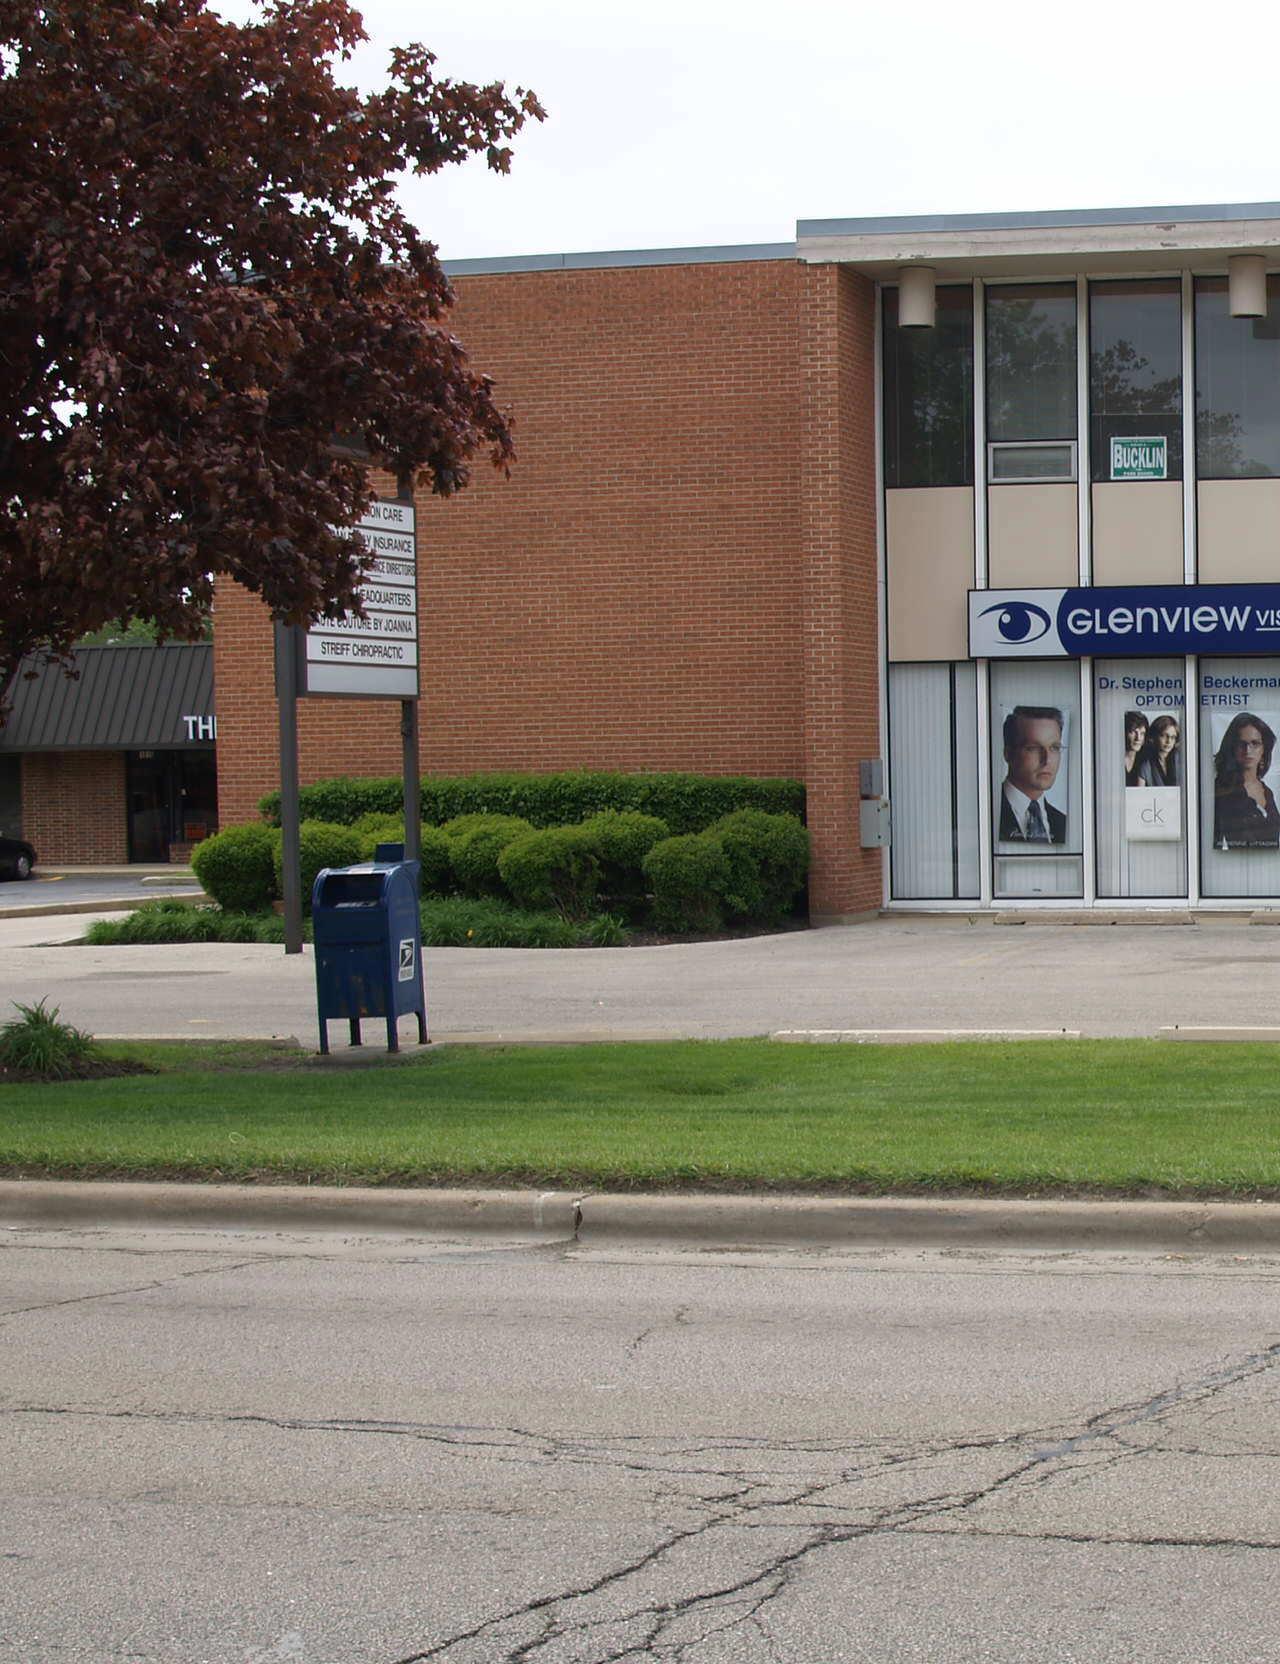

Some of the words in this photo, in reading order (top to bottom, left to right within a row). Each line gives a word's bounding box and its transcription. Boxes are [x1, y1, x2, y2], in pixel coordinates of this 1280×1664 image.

[1114, 444, 1164, 468] BUCKLIN
[382, 507, 403, 522] CARE
[373, 536, 413, 553] INSURANCE
[386, 561, 416, 577] DIRECTORS
[373, 618, 383, 631] BY
[384, 619, 413, 633] JOANNA
[321, 641, 351, 656] STREIFF
[352, 643, 404, 660] CHIROPRACTIC
[1099, 677, 1119, 690] Dr.
[1122, 676, 1183, 694] Stephen
[183, 715, 217, 740] TH
